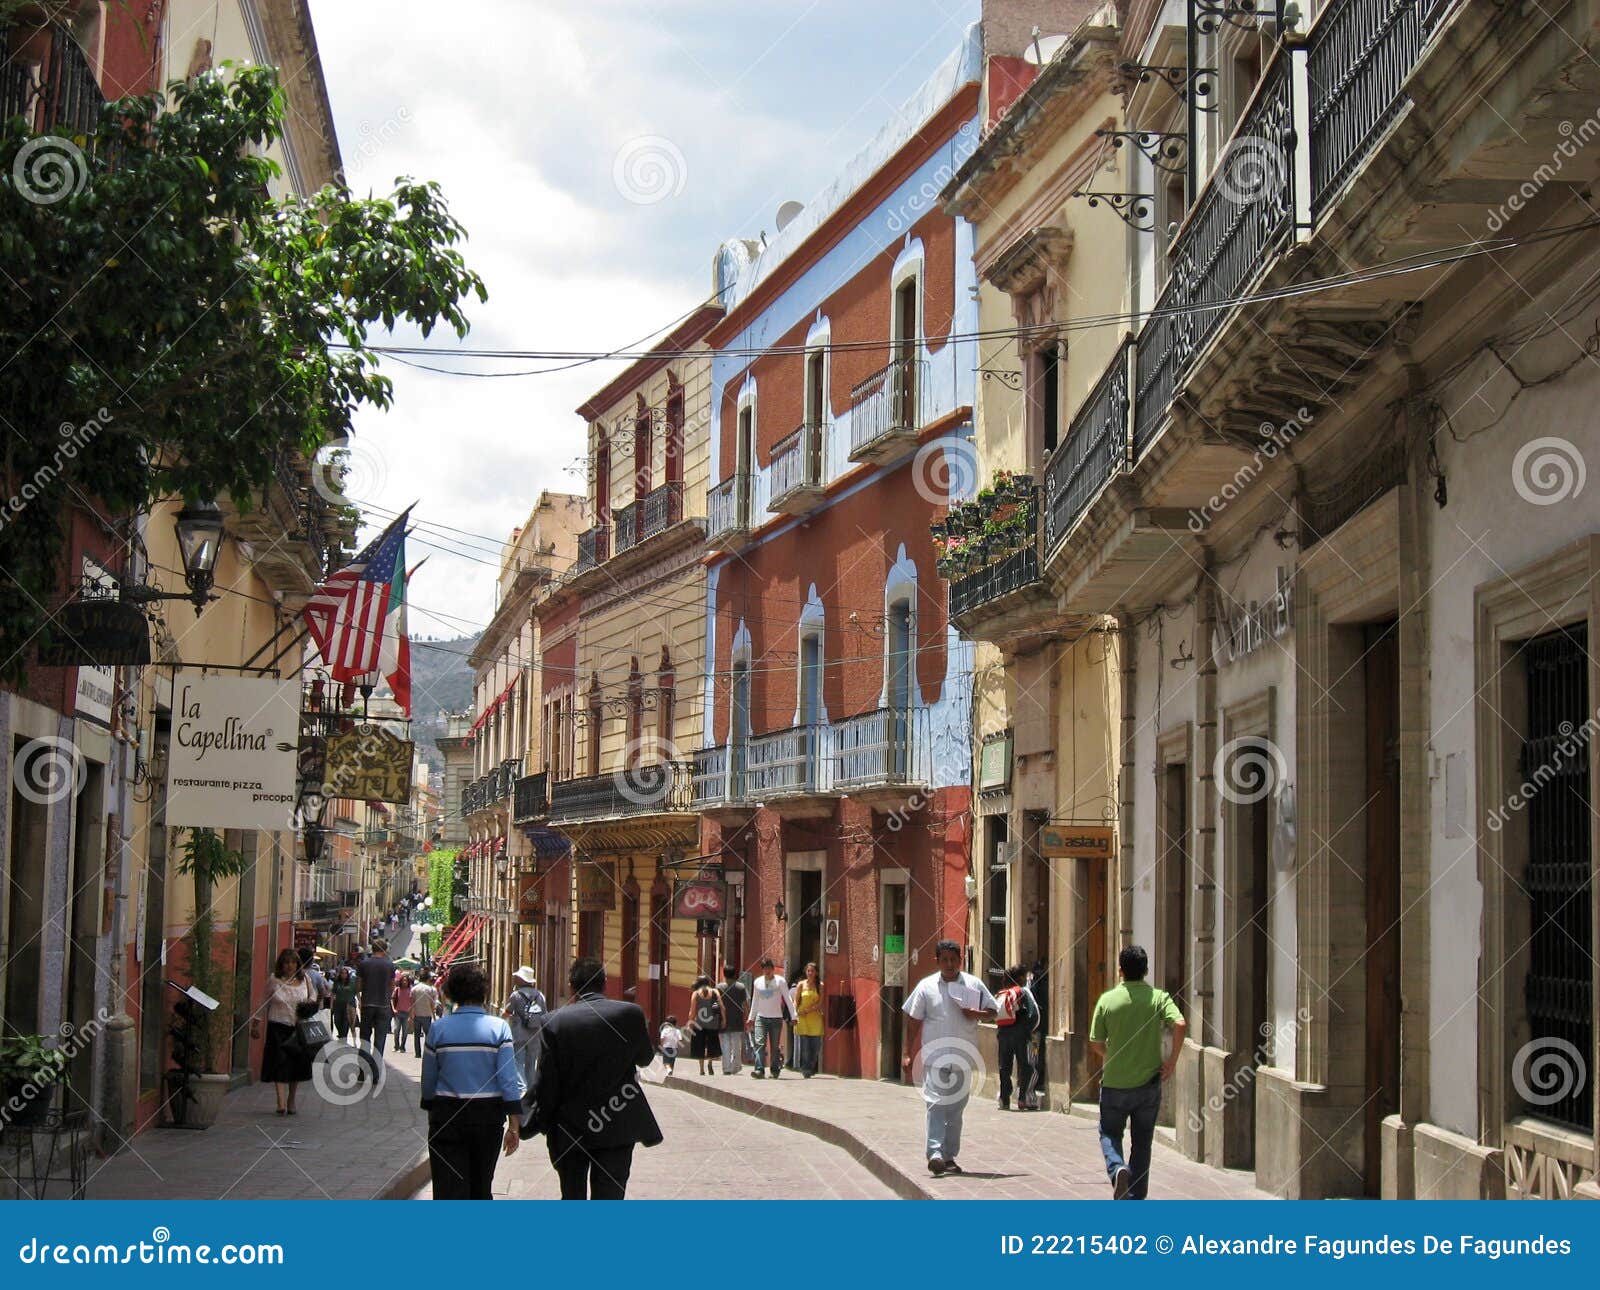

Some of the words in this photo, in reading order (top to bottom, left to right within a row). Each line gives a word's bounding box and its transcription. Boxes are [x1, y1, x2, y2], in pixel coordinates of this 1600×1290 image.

[181, 685, 201, 719] la
[177, 716, 267, 761] Capellina
[252, 792, 293, 803] precopa
